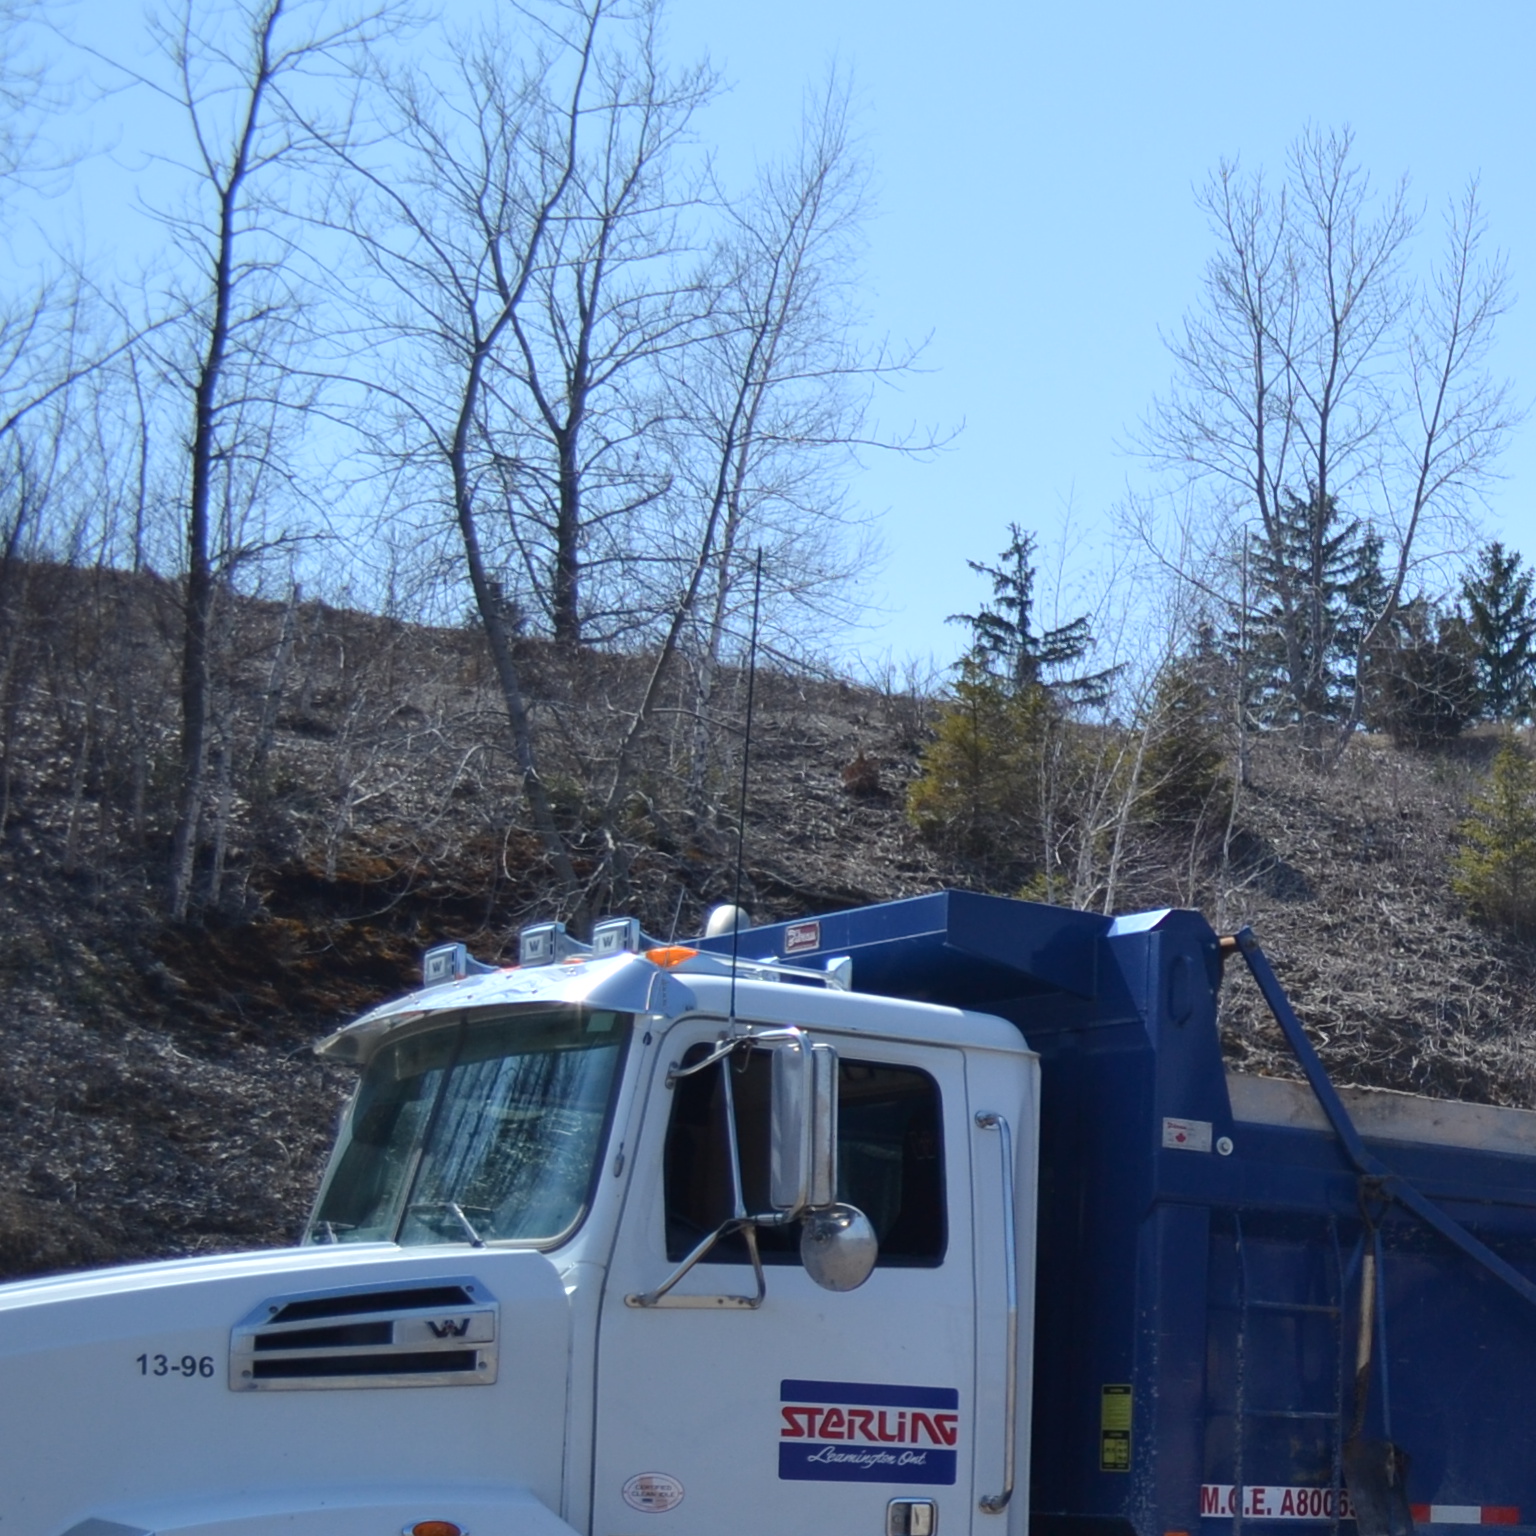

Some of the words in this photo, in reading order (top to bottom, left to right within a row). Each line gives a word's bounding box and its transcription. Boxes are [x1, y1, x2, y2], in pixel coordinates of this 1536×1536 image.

[136, 1354, 215, 1378] 13-96
[807, 1446, 896, 1469] Leamington
[897, 1450, 927, 1466] Ont.
